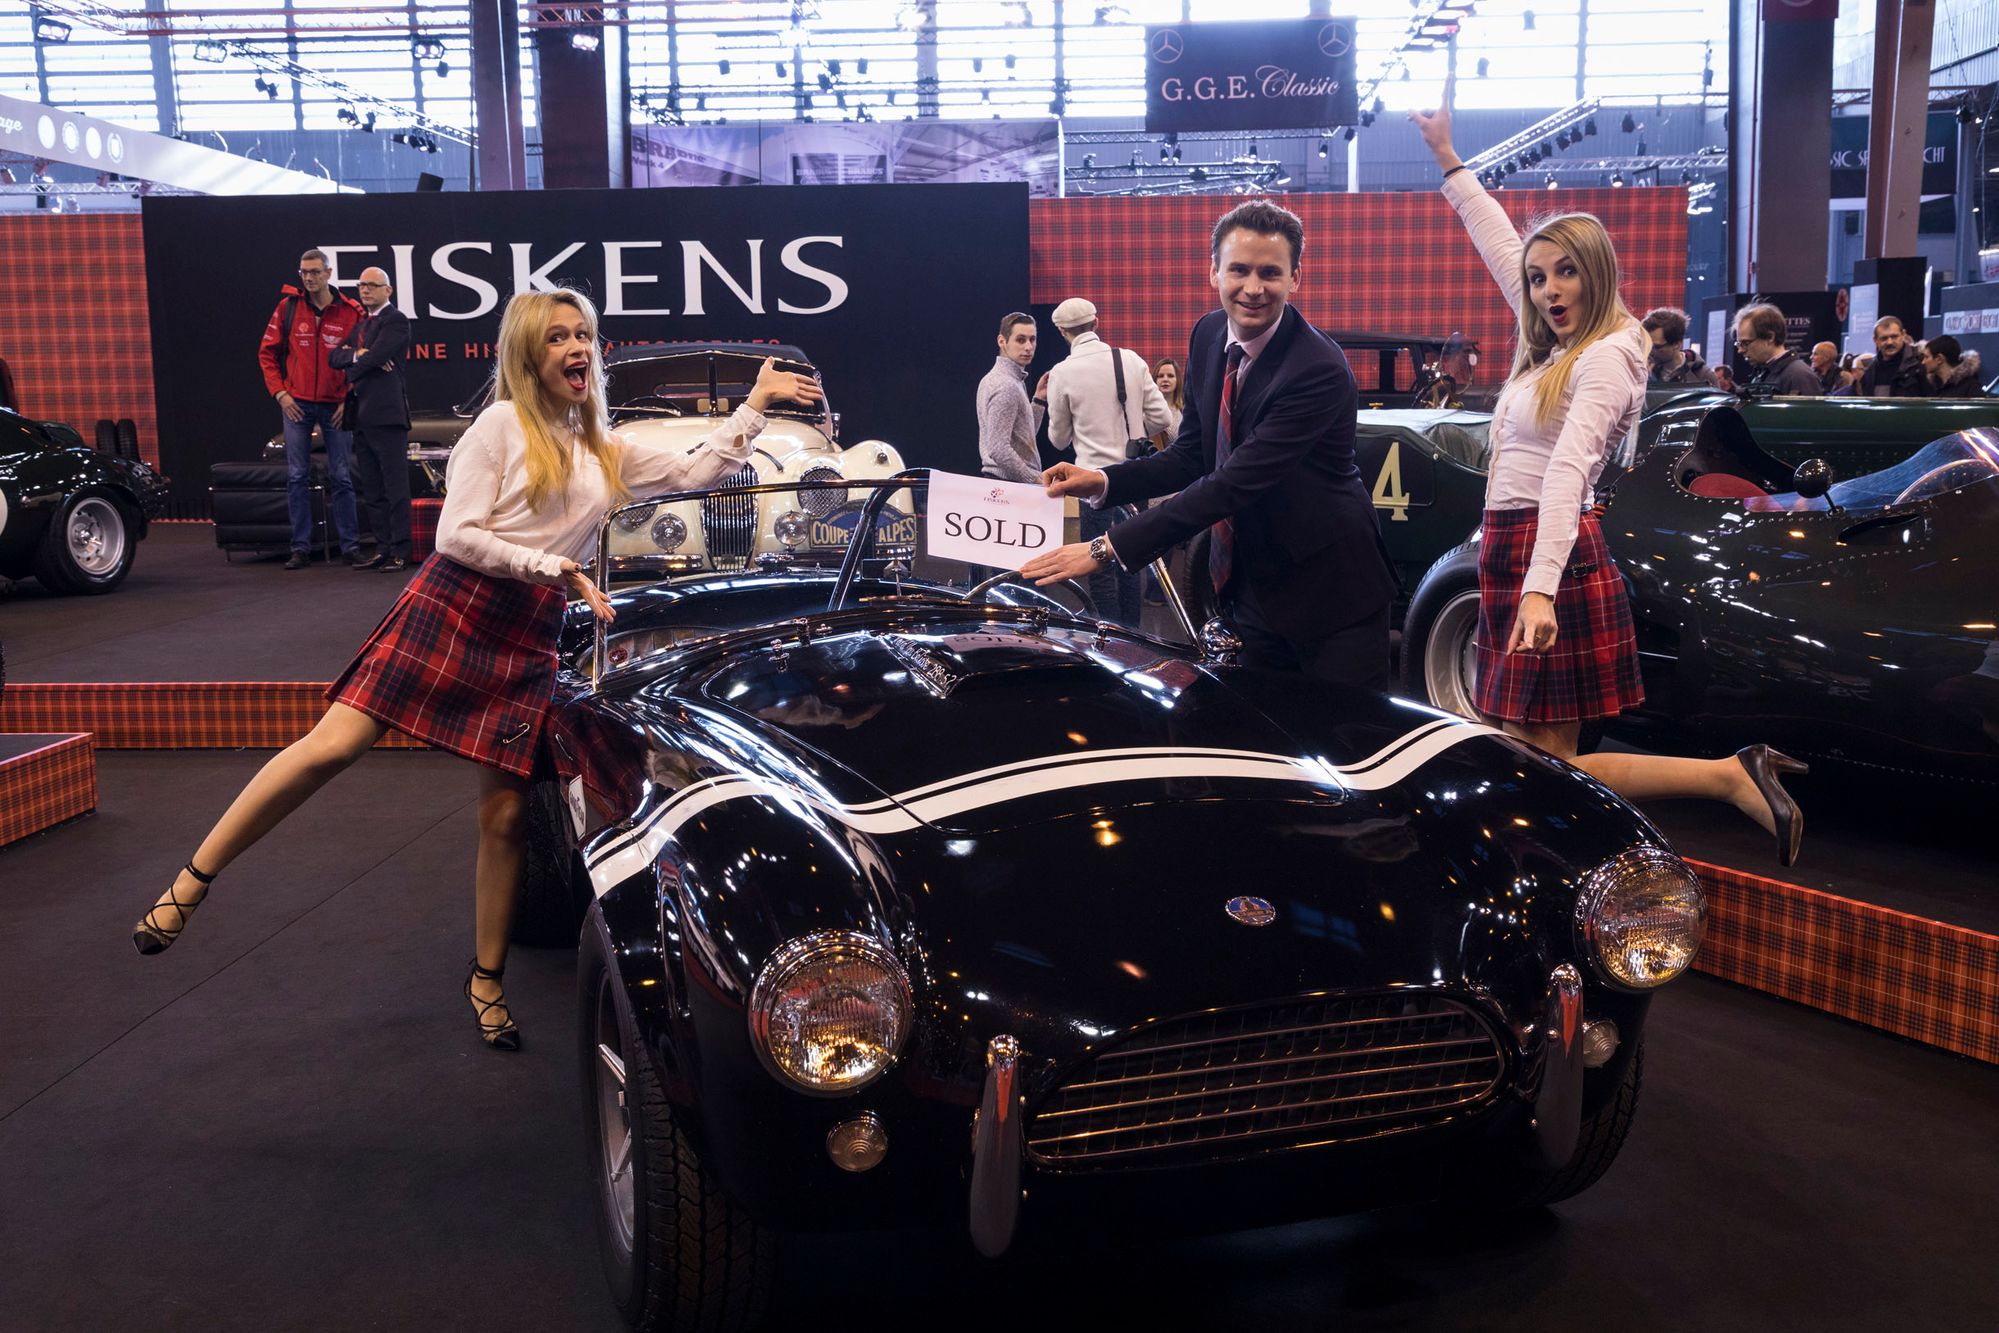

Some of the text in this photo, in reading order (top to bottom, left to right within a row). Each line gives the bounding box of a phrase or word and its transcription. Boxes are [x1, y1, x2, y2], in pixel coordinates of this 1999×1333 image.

[1162, 65, 1340, 101] G.G.E. Classic
[1372, 442, 1410, 521] 4
[812, 520, 849, 544] COUPE
[879, 517, 915, 543] ALPES
[945, 512, 1046, 549] SOLD
